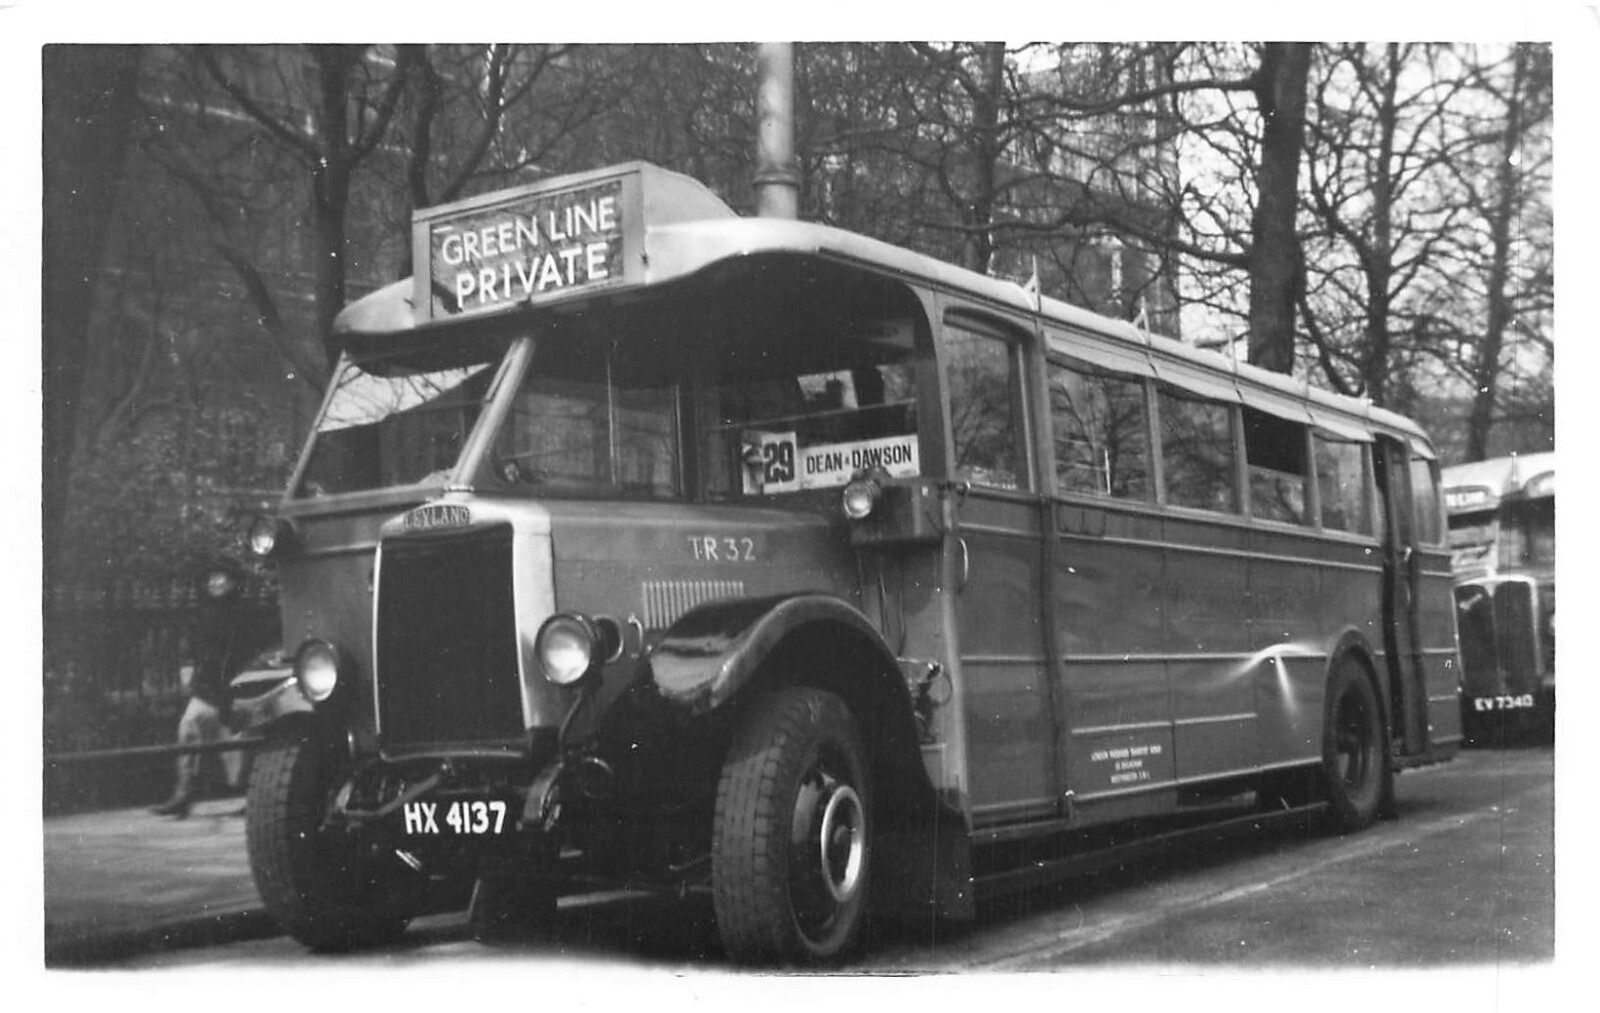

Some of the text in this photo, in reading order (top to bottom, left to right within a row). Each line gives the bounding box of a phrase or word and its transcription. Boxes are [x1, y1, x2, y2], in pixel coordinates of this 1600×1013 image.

[441, 196, 616, 265] GREEN LINE
[456, 242, 609, 308] PRIVATE
[806, 452, 843, 475] DEAN
[852, 444, 912, 469] DAWSON
[404, 506, 469, 529] LEYLAND
[723, 537, 756, 561] 32
[404, 801, 507, 835] HX 4137
